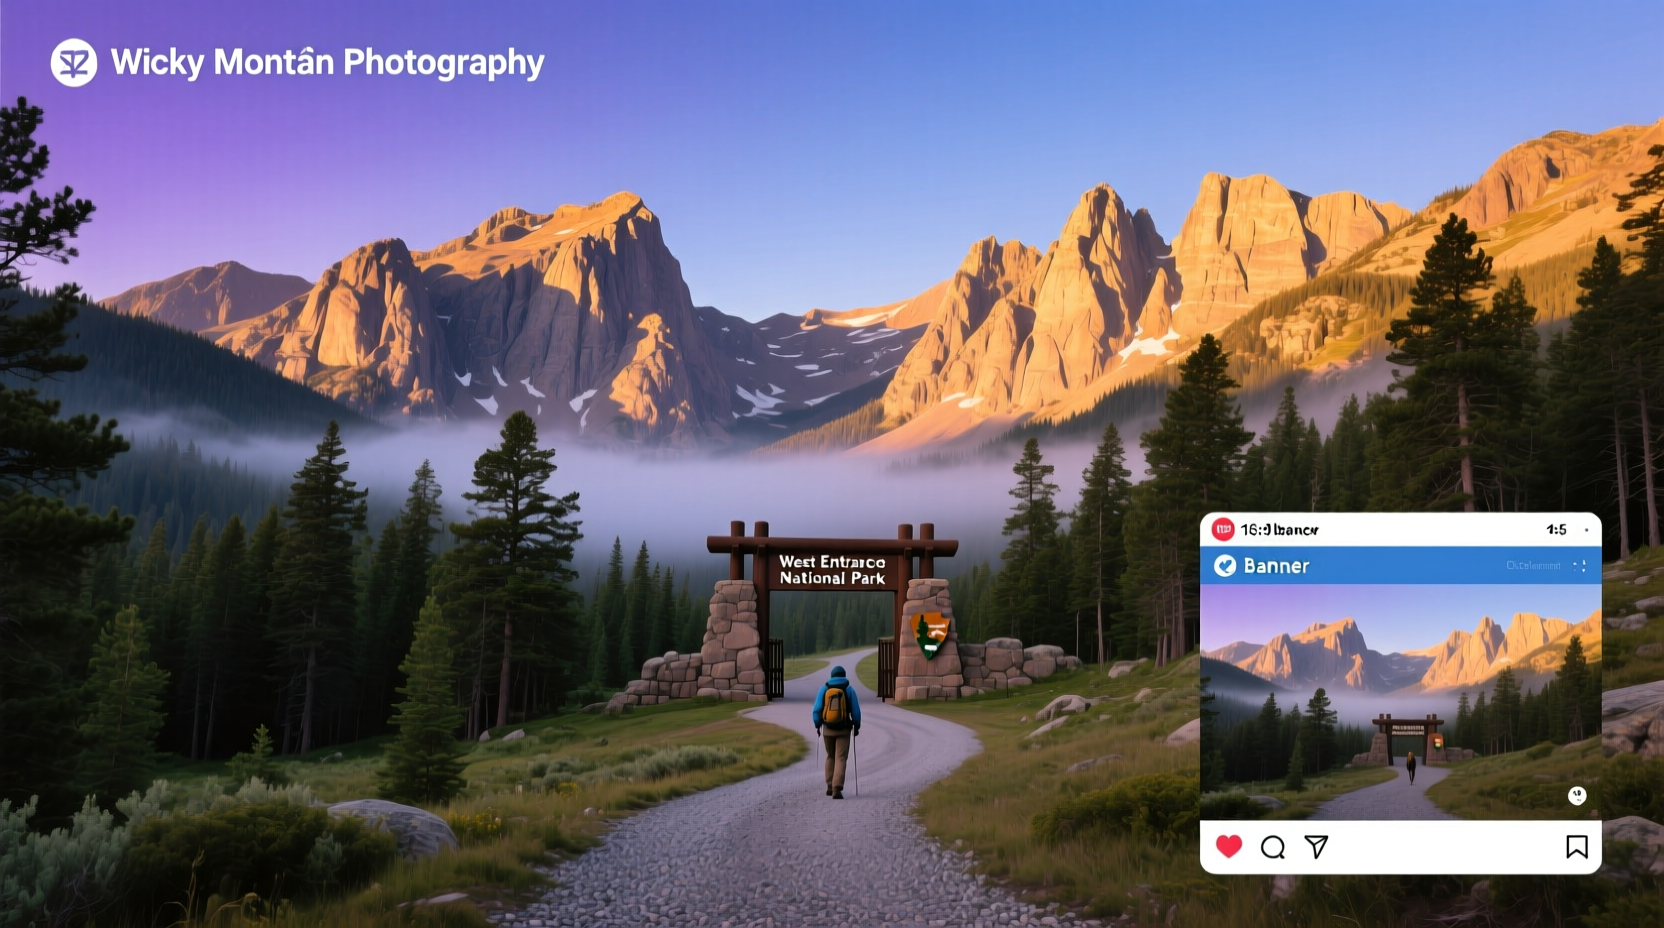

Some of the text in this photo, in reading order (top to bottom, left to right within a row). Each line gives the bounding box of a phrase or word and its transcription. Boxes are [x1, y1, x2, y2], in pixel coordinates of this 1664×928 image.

[779, 554, 816, 569] West
[780, 571, 887, 586] National Park
